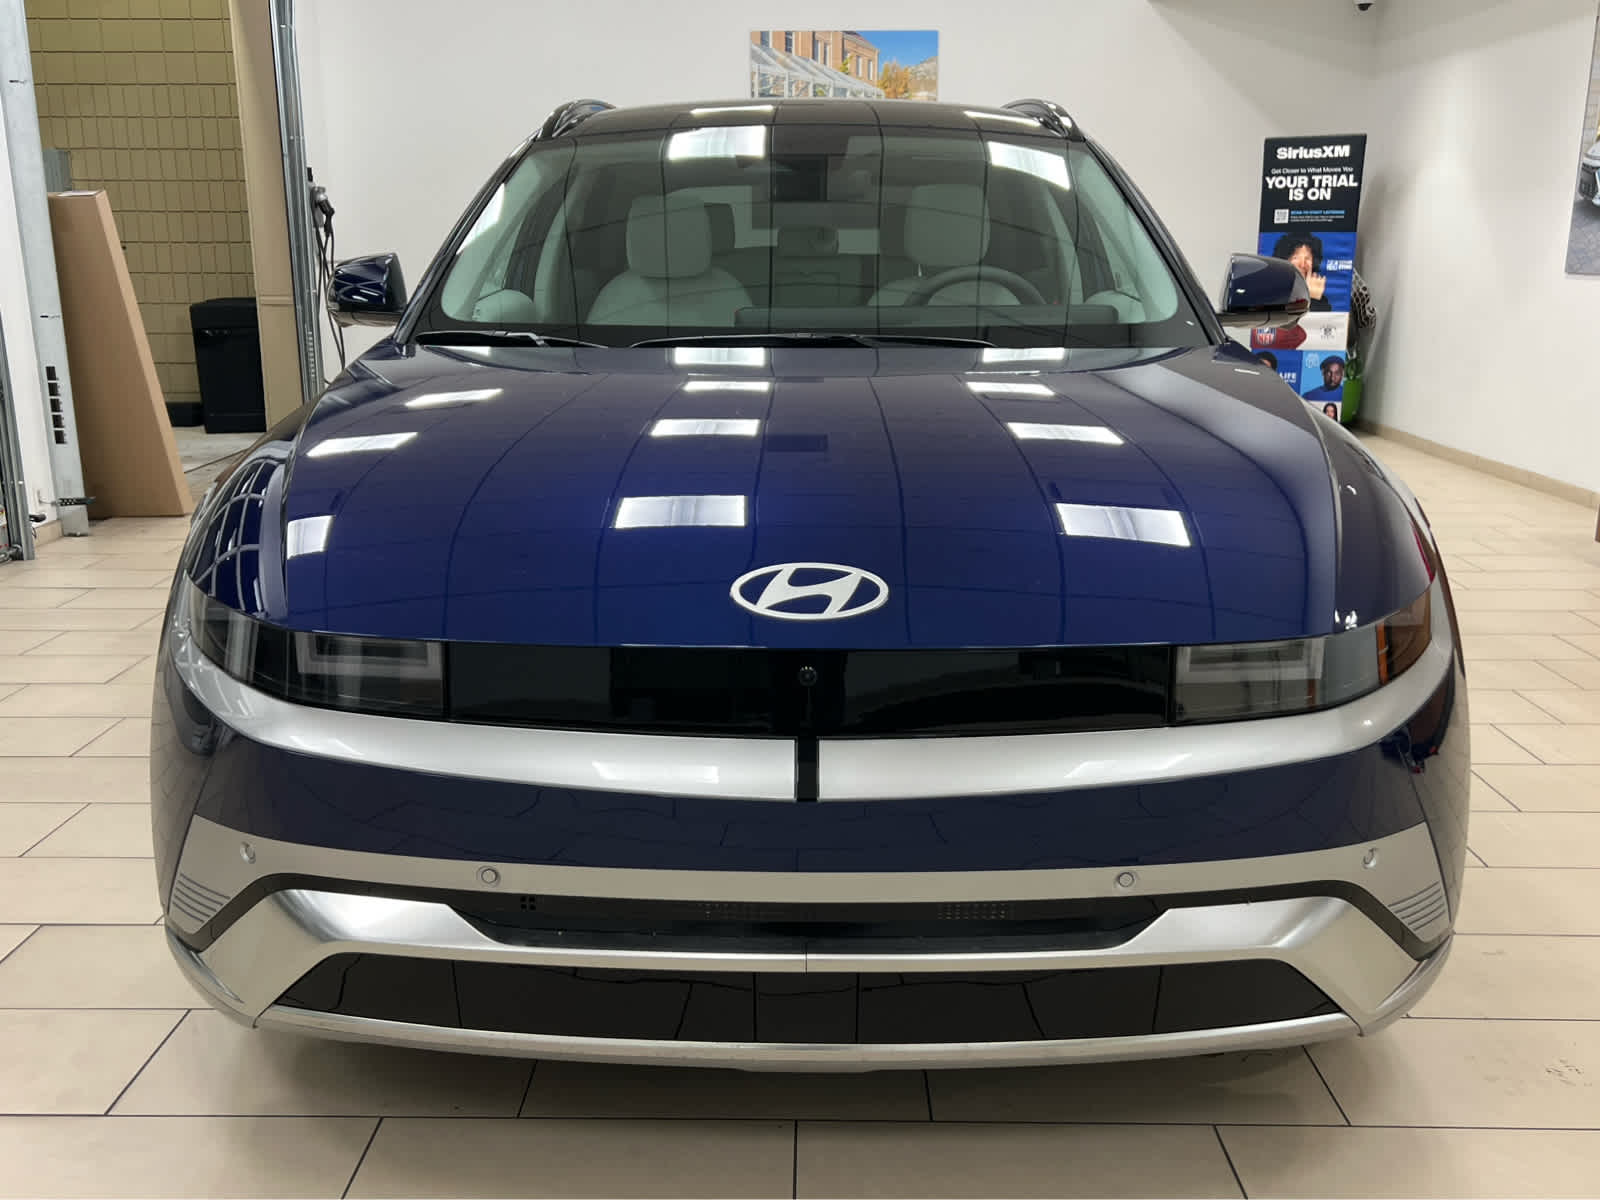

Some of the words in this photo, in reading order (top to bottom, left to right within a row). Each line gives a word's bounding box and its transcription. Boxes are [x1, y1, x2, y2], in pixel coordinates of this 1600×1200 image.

[1276, 145, 1351, 159] SiriusXM
[1265, 175, 1309, 189] YOUR
[1311, 174, 1358, 188] TRIAL
[1288, 188, 1304, 201] IS
[1307, 188, 1332, 201] ON
